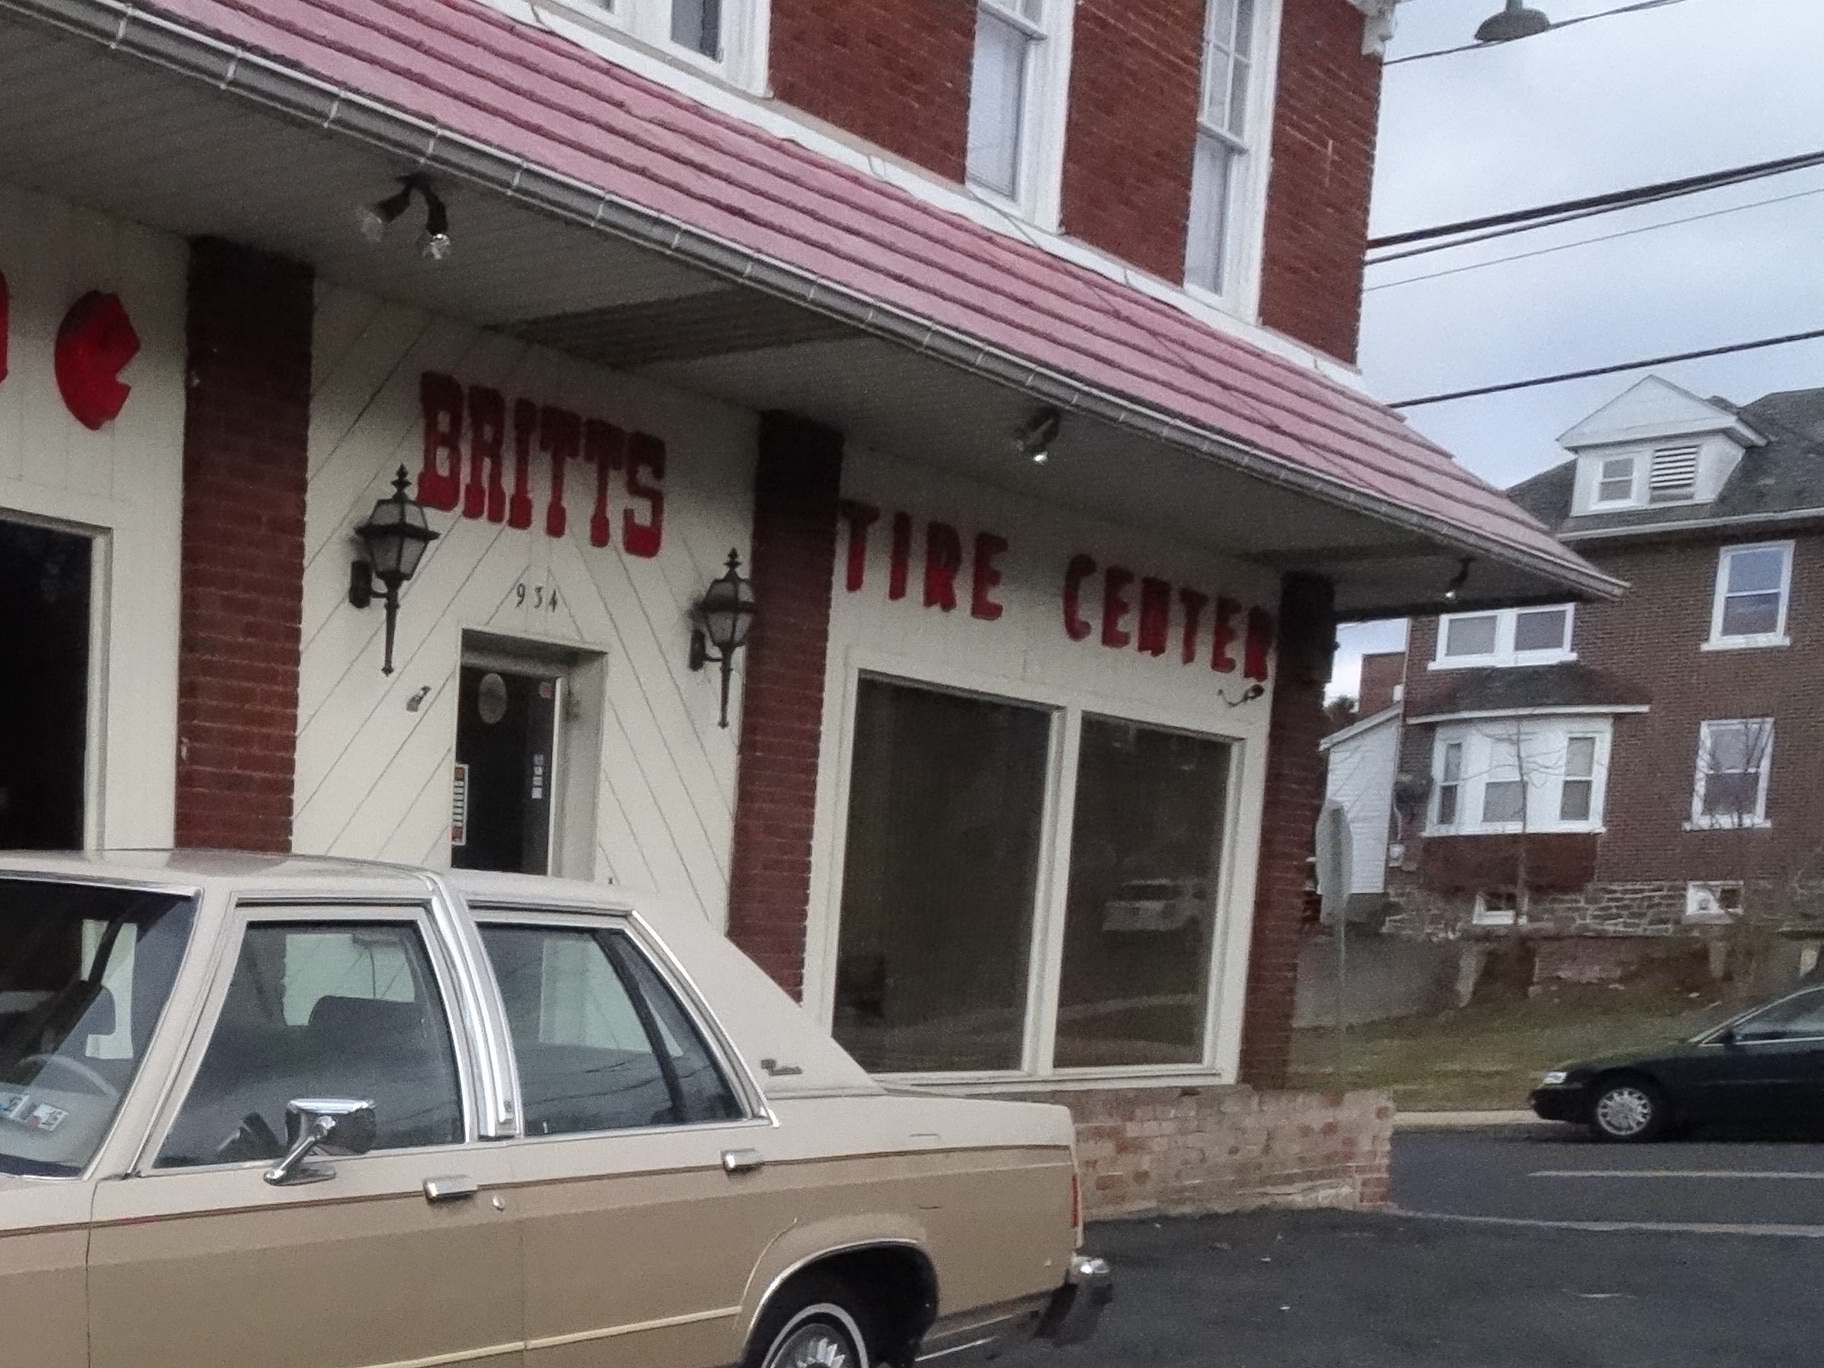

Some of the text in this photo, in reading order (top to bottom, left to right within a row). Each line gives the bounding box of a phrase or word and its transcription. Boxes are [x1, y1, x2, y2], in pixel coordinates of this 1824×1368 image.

[416, 369, 667, 558] BRITTS
[515, 583, 558, 613] 934
[839, 500, 1275, 682] TIRE CENTER
